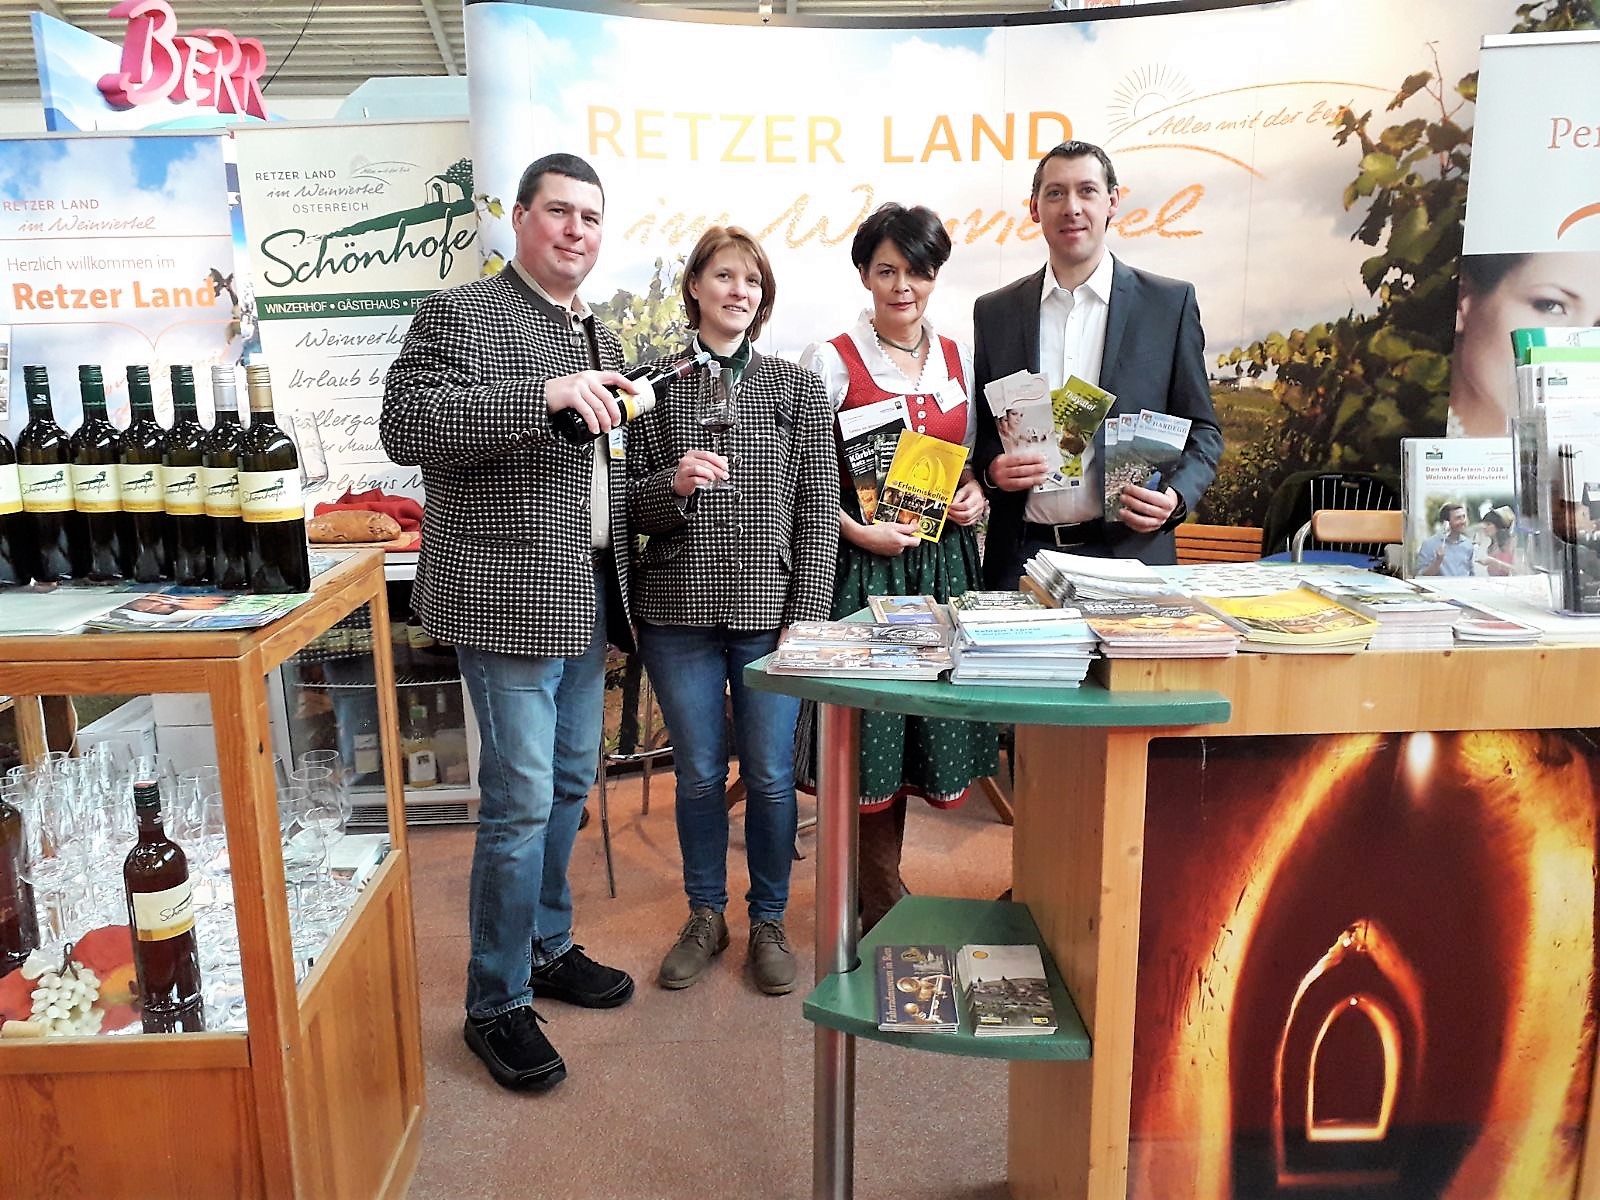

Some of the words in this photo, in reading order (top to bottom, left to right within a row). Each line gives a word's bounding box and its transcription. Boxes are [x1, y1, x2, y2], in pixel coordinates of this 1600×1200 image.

[1147, 115, 1212, 136] Alles
[1215, 110, 1263, 130] mit
[1263, 106, 1303, 129] der
[586, 104, 846, 164] RETZER
[882, 110, 1075, 164] LAND
[255, 171, 300, 182] RETZER
[304, 169, 336, 181] LAND
[266, 189, 290, 199] im
[293, 182, 385, 198] Weinviertel
[3, 200, 55, 211] RETZER
[62, 199, 99, 210] LAND
[18, 220, 44, 232] im
[47, 214, 156, 232] Weinviertel
[7, 256, 62, 272] Herzlich
[66, 255, 153, 270] willkommen
[157, 254, 176, 269] im
[12, 282, 123, 310] Retzer
[132, 276, 216, 309] Land
[265, 301, 328, 314] WINZERHOF
[337, 297, 401, 311] GÄSTEHAUS
[289, 367, 361, 389] Urlaub
